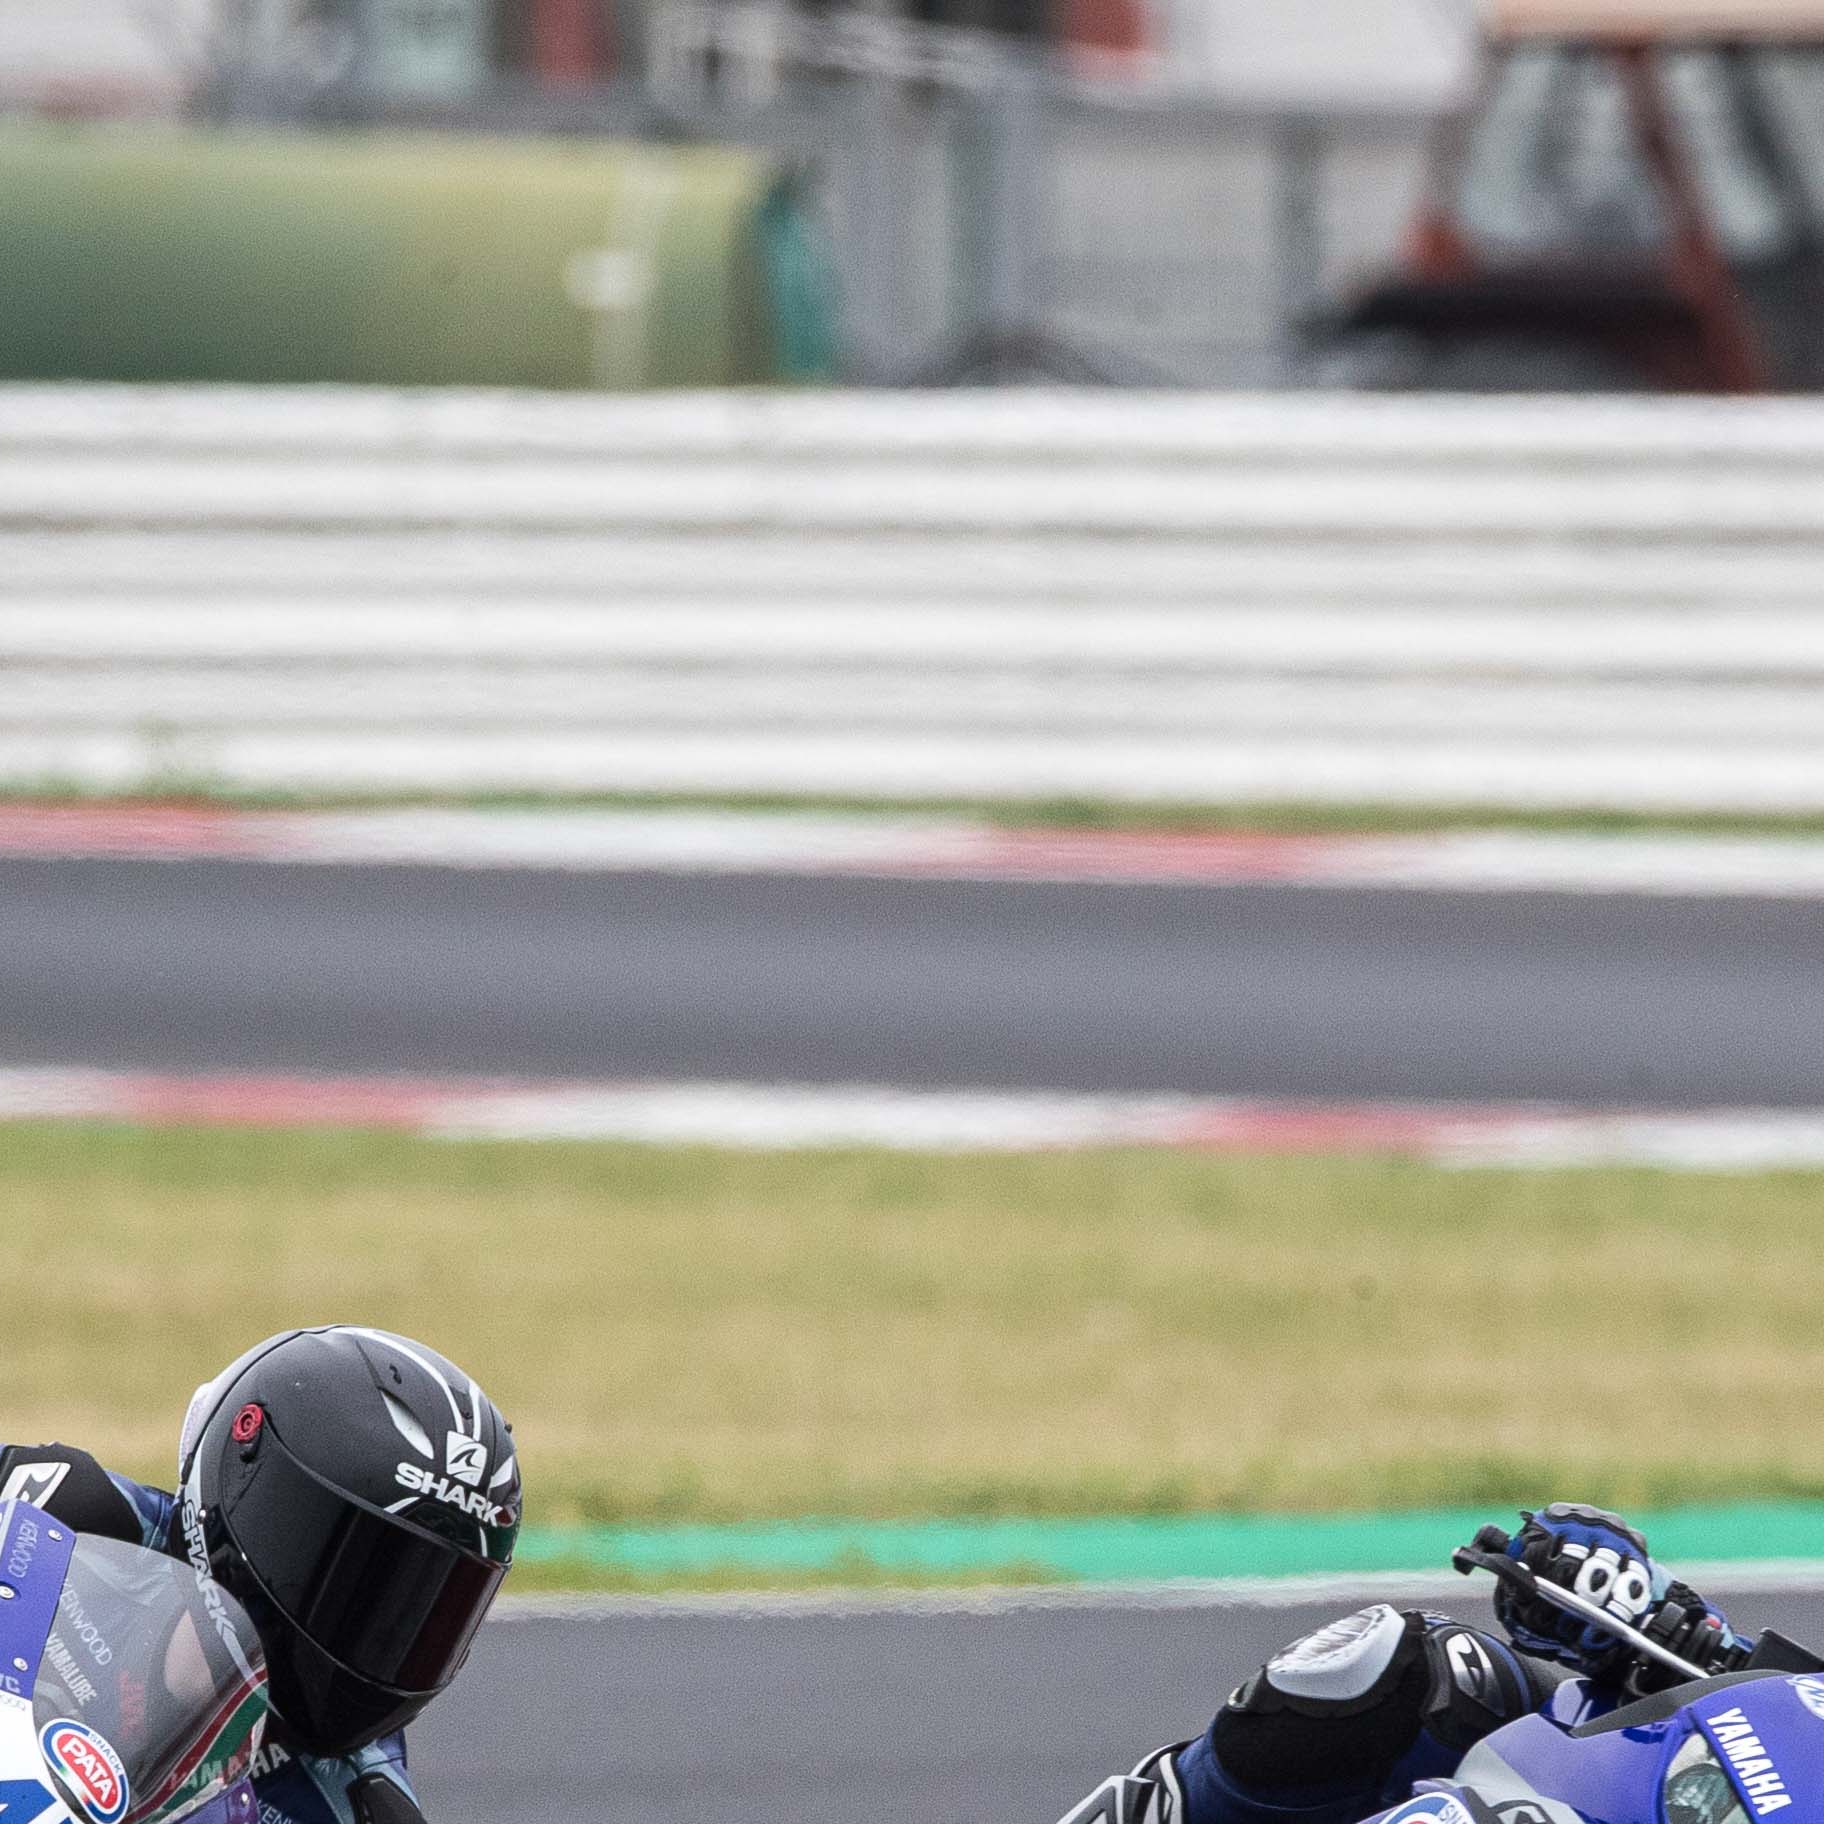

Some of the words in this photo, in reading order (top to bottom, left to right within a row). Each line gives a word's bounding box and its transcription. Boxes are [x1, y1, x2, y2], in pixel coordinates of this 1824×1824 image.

[394, 1461, 502, 1528] SHARK
[180, 1495, 238, 1637] SHARK
[62, 1737, 117, 1808] PATA
[87, 1732, 124, 1776] SNACK
[1705, 1707, 1793, 1817] YAMAHA
